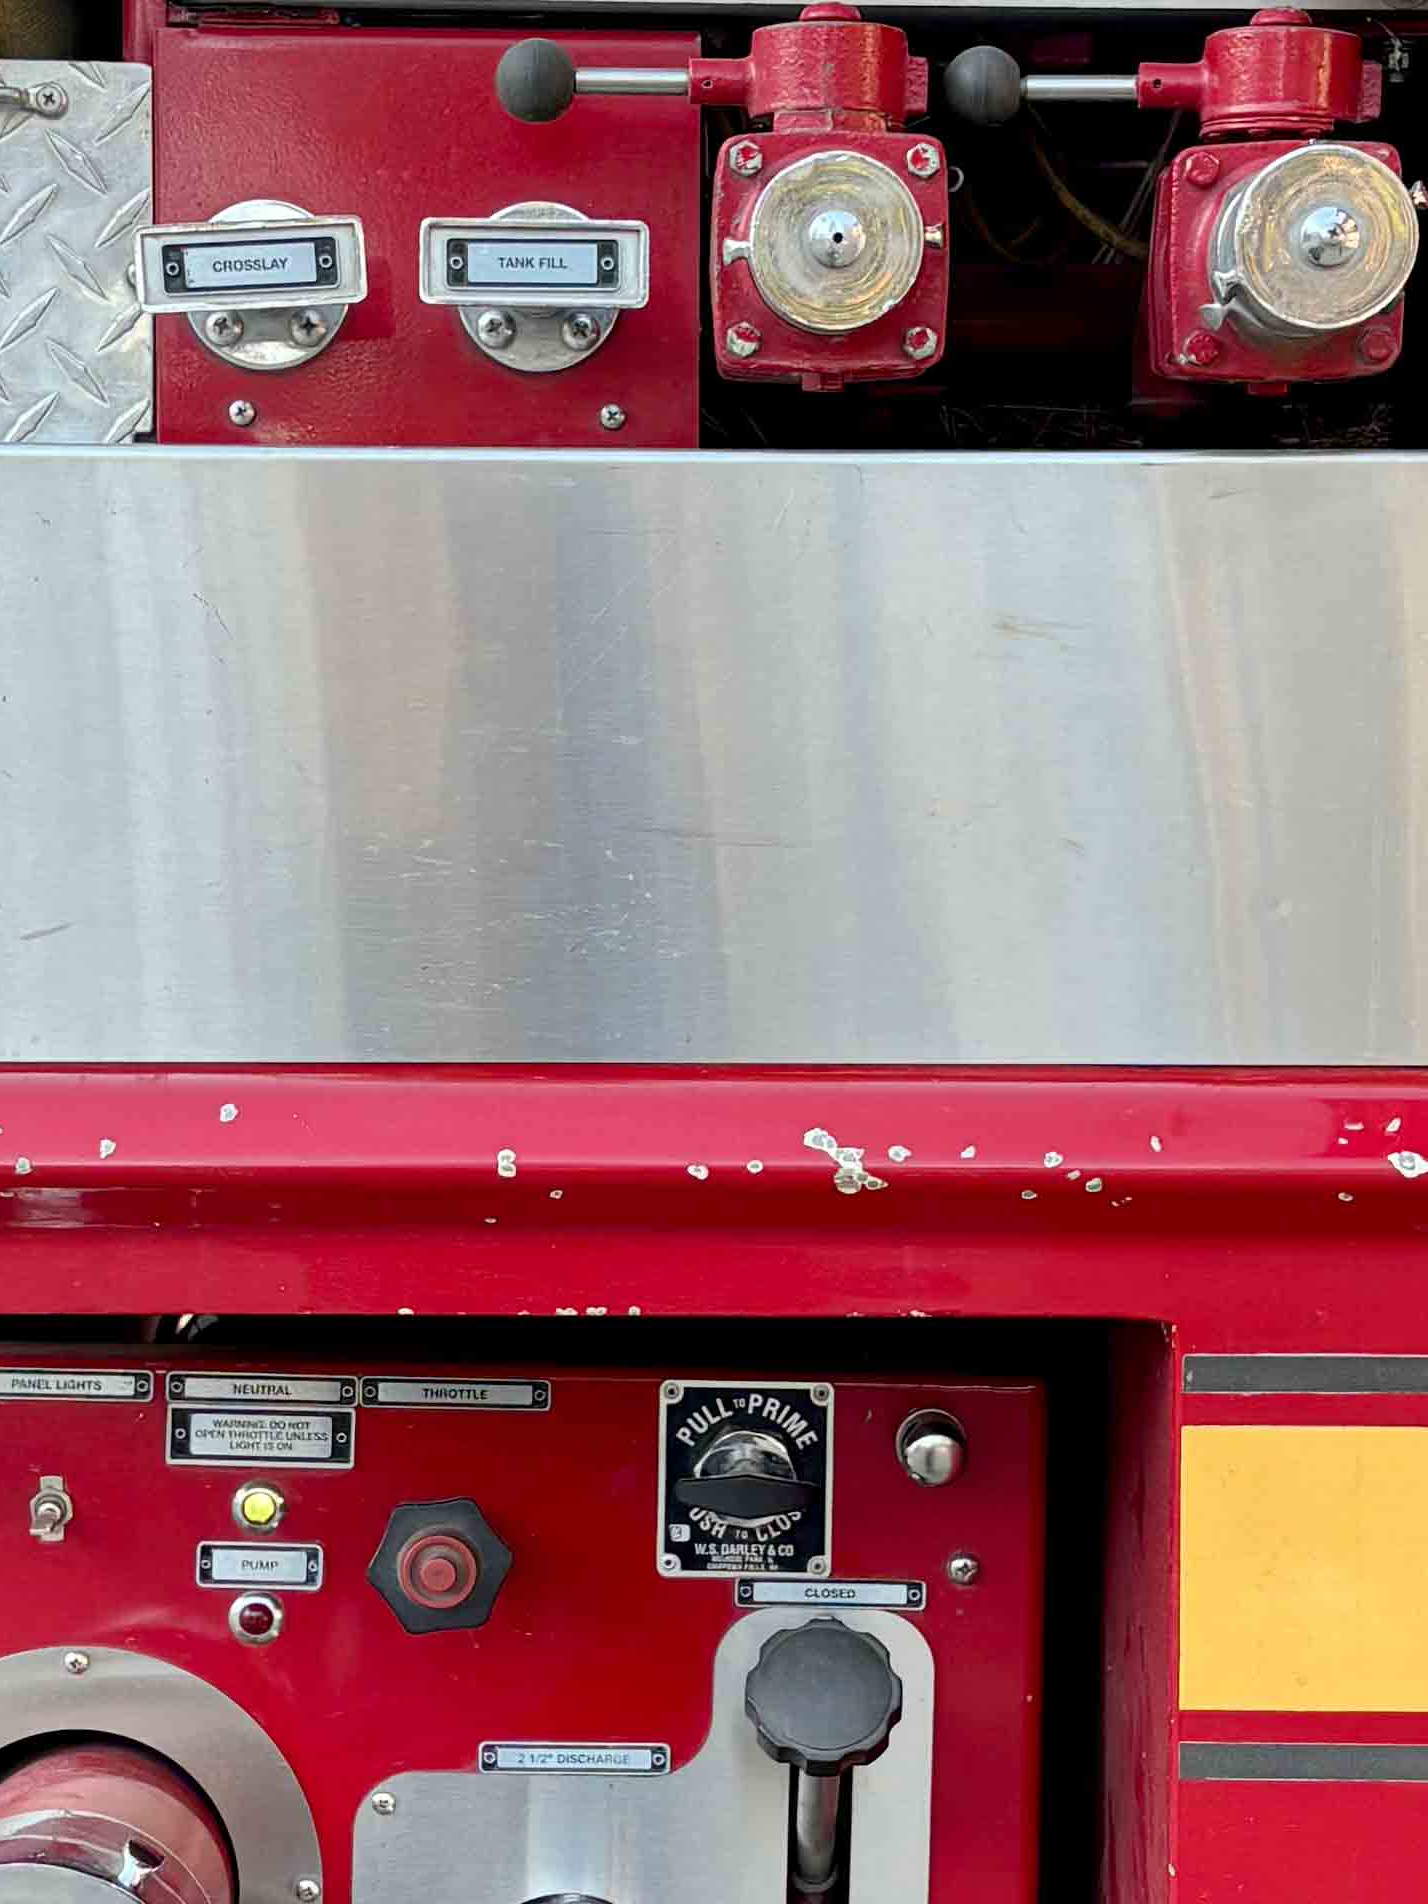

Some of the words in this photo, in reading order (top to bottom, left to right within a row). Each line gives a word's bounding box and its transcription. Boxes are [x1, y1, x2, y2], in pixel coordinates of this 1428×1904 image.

[212, 257, 289, 273] CROSSLAY
[497, 257, 535, 269] TANK
[539, 258, 568, 270] FILL
[11, 1378, 50, 1391] PANEL
[57, 1379, 102, 1392] LIGHTS
[233, 1383, 292, 1396] NEUTRAL
[423, 1387, 488, 1401] THROTTLE
[288, 1421, 310, 1430] NOT
[676, 1397, 733, 1446] PULL
[748, 1393, 818, 1450] PRIME
[229, 1431, 284, 1440] THROTTLE
[285, 1431, 329, 1441] UNLESS
[230, 1441, 262, 1450] LIGHT
[276, 1442, 292, 1451] ON
[689, 1507, 727, 1539] USH
[735, 1529, 748, 1539] TO
[720, 1542, 766, 1557] DARLEY
[241, 1558, 279, 1571] PUMP
[805, 1588, 856, 1599] CLOSED
[518, 1753, 526, 1764] 2
[557, 1753, 631, 1765] DISCHARGE
